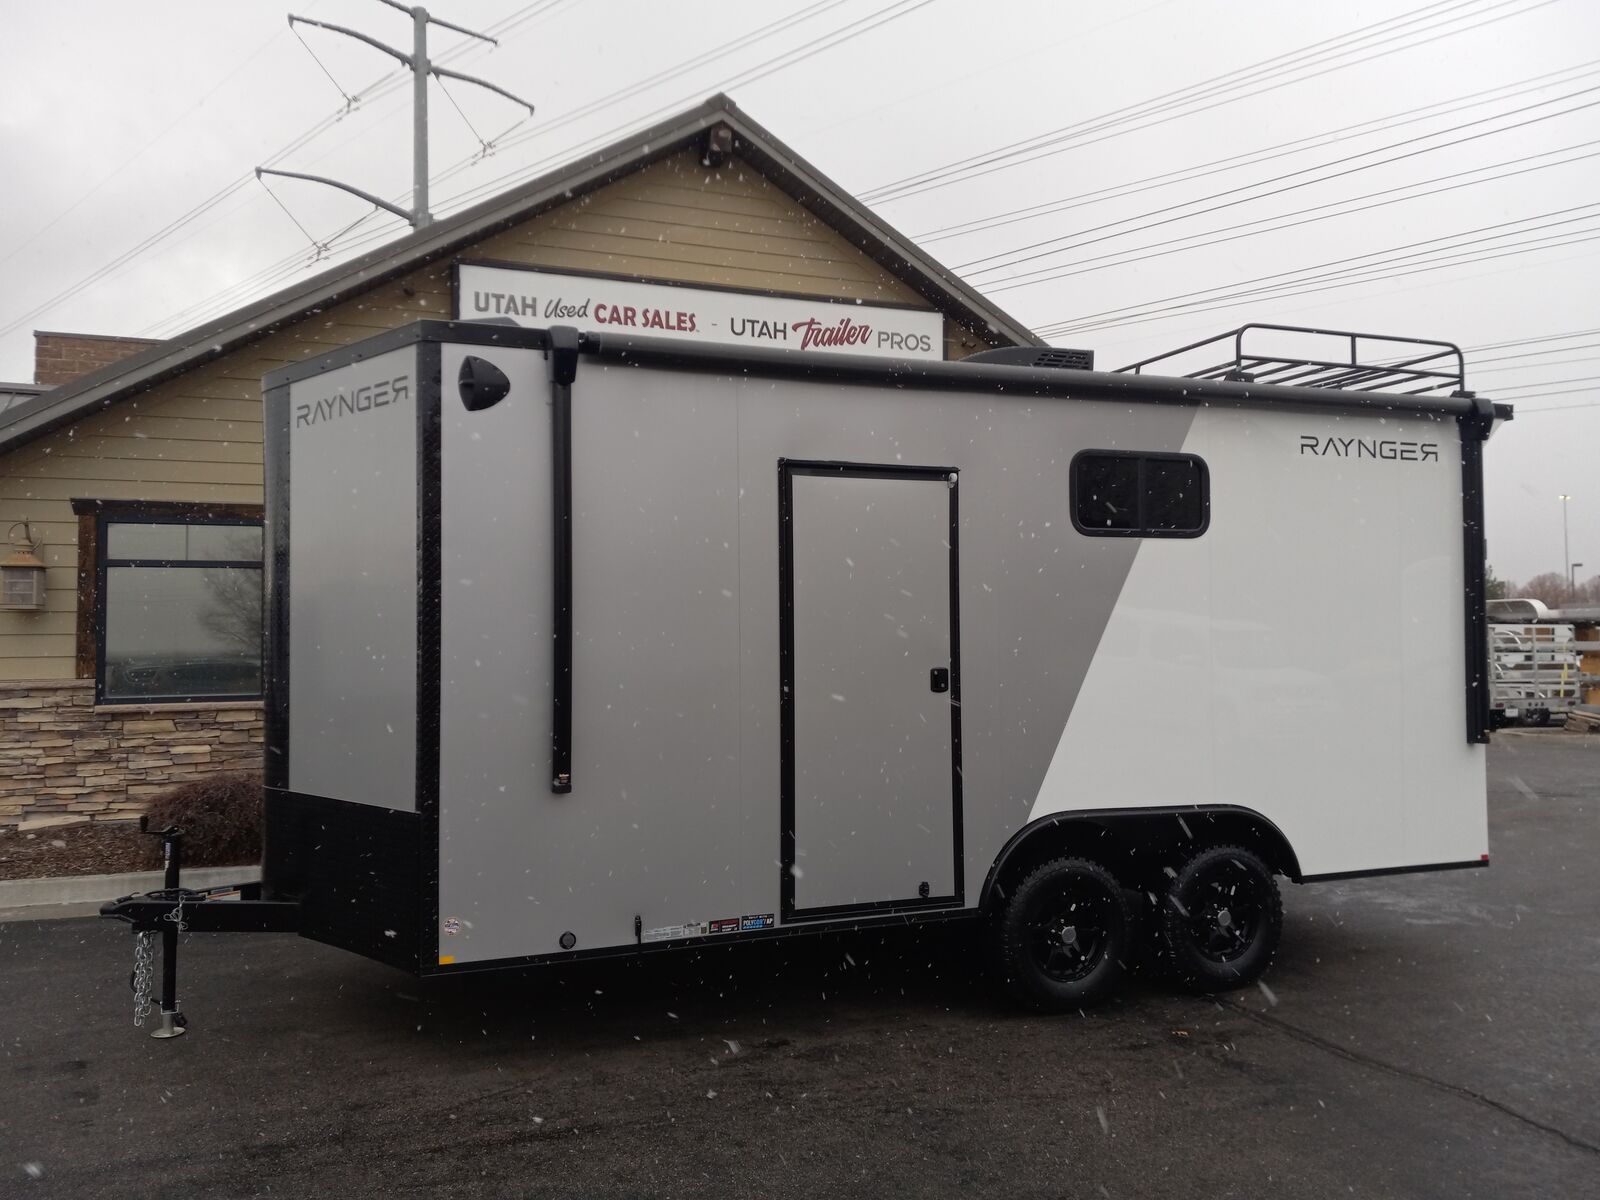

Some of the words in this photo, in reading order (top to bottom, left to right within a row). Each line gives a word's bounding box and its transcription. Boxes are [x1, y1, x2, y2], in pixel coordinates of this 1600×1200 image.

[474, 291, 537, 317] UTAH
[544, 298, 591, 319] Used
[594, 303, 637, 327] CAR
[642, 308, 696, 332] SALES
[730, 317, 787, 340] UTAH
[792, 317, 873, 350] Trailer
[877, 331, 931, 352] PROS
[296, 375, 409, 429] RAYNGER
[1300, 435, 1438, 462] RAYNGER
